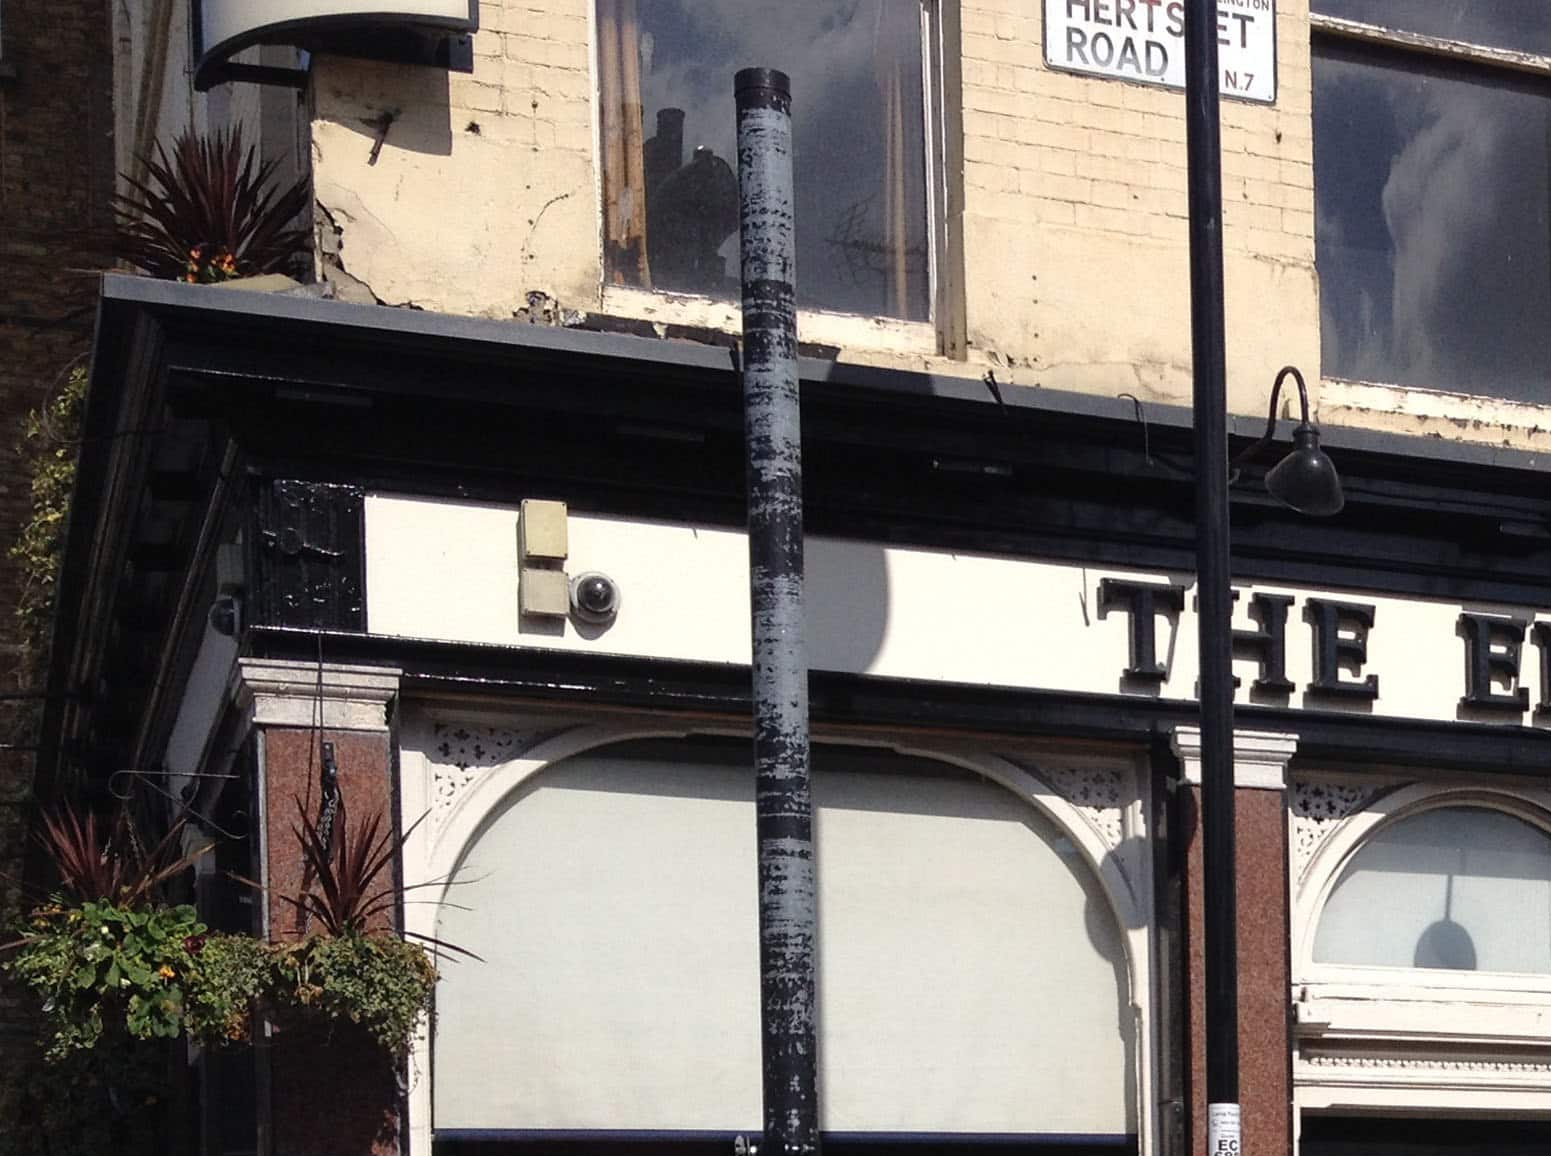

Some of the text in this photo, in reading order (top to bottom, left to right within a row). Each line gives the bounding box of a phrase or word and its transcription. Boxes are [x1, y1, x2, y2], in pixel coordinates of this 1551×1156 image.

[1066, 0, 1255, 49] HERTSET
[1066, 26, 1169, 77] ROAD
[1097, 577, 1379, 700] THE
[1218, 1139, 1238, 1152] EC
